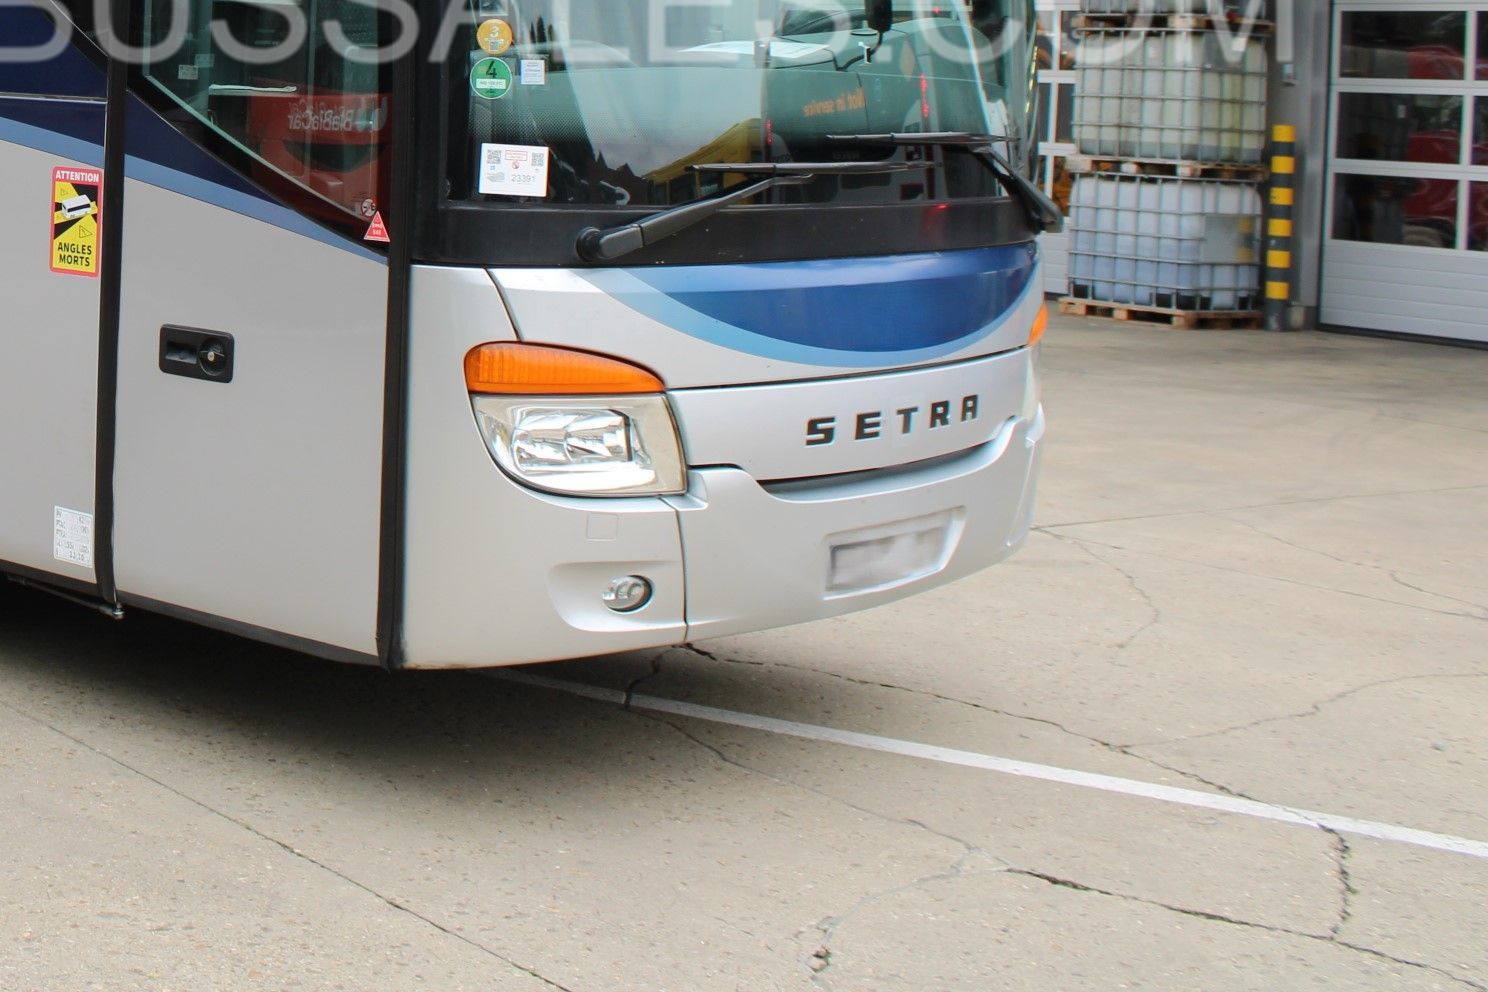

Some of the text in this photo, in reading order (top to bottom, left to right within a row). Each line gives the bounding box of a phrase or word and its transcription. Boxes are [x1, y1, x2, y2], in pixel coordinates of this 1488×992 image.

[485, 60, 498, 79] 4
[55, 169, 100, 183] ATTENTION
[57, 242, 92, 255] ANGLES
[58, 253, 91, 267] MORTS
[805, 394, 979, 446] SETRA
